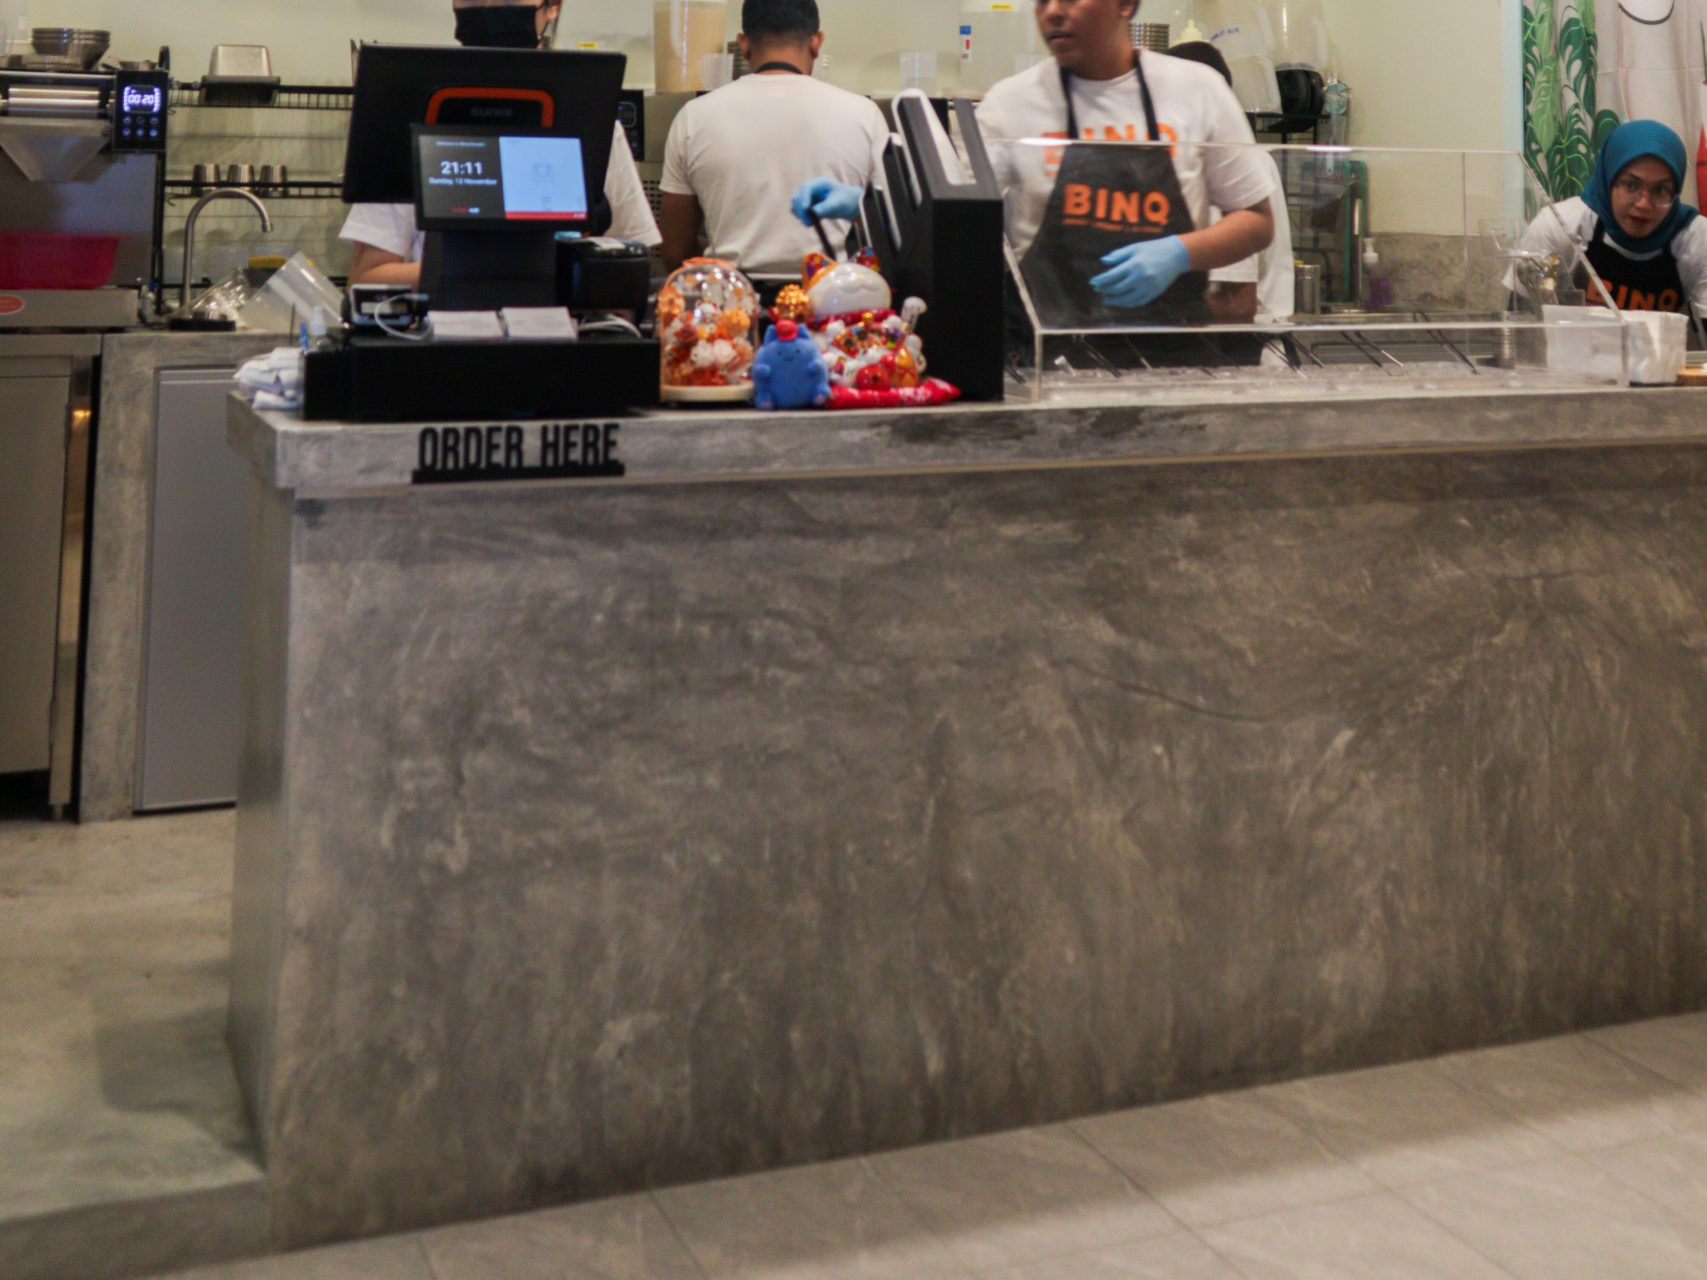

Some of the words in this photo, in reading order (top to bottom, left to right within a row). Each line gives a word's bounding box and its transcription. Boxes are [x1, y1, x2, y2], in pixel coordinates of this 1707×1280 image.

[440, 160, 483, 176] 21:11
[1063, 183, 1170, 226] BINQ
[1586, 277, 1680, 311] BINQ
[419, 425, 523, 470] ORDER
[541, 423, 620, 467] HERE
